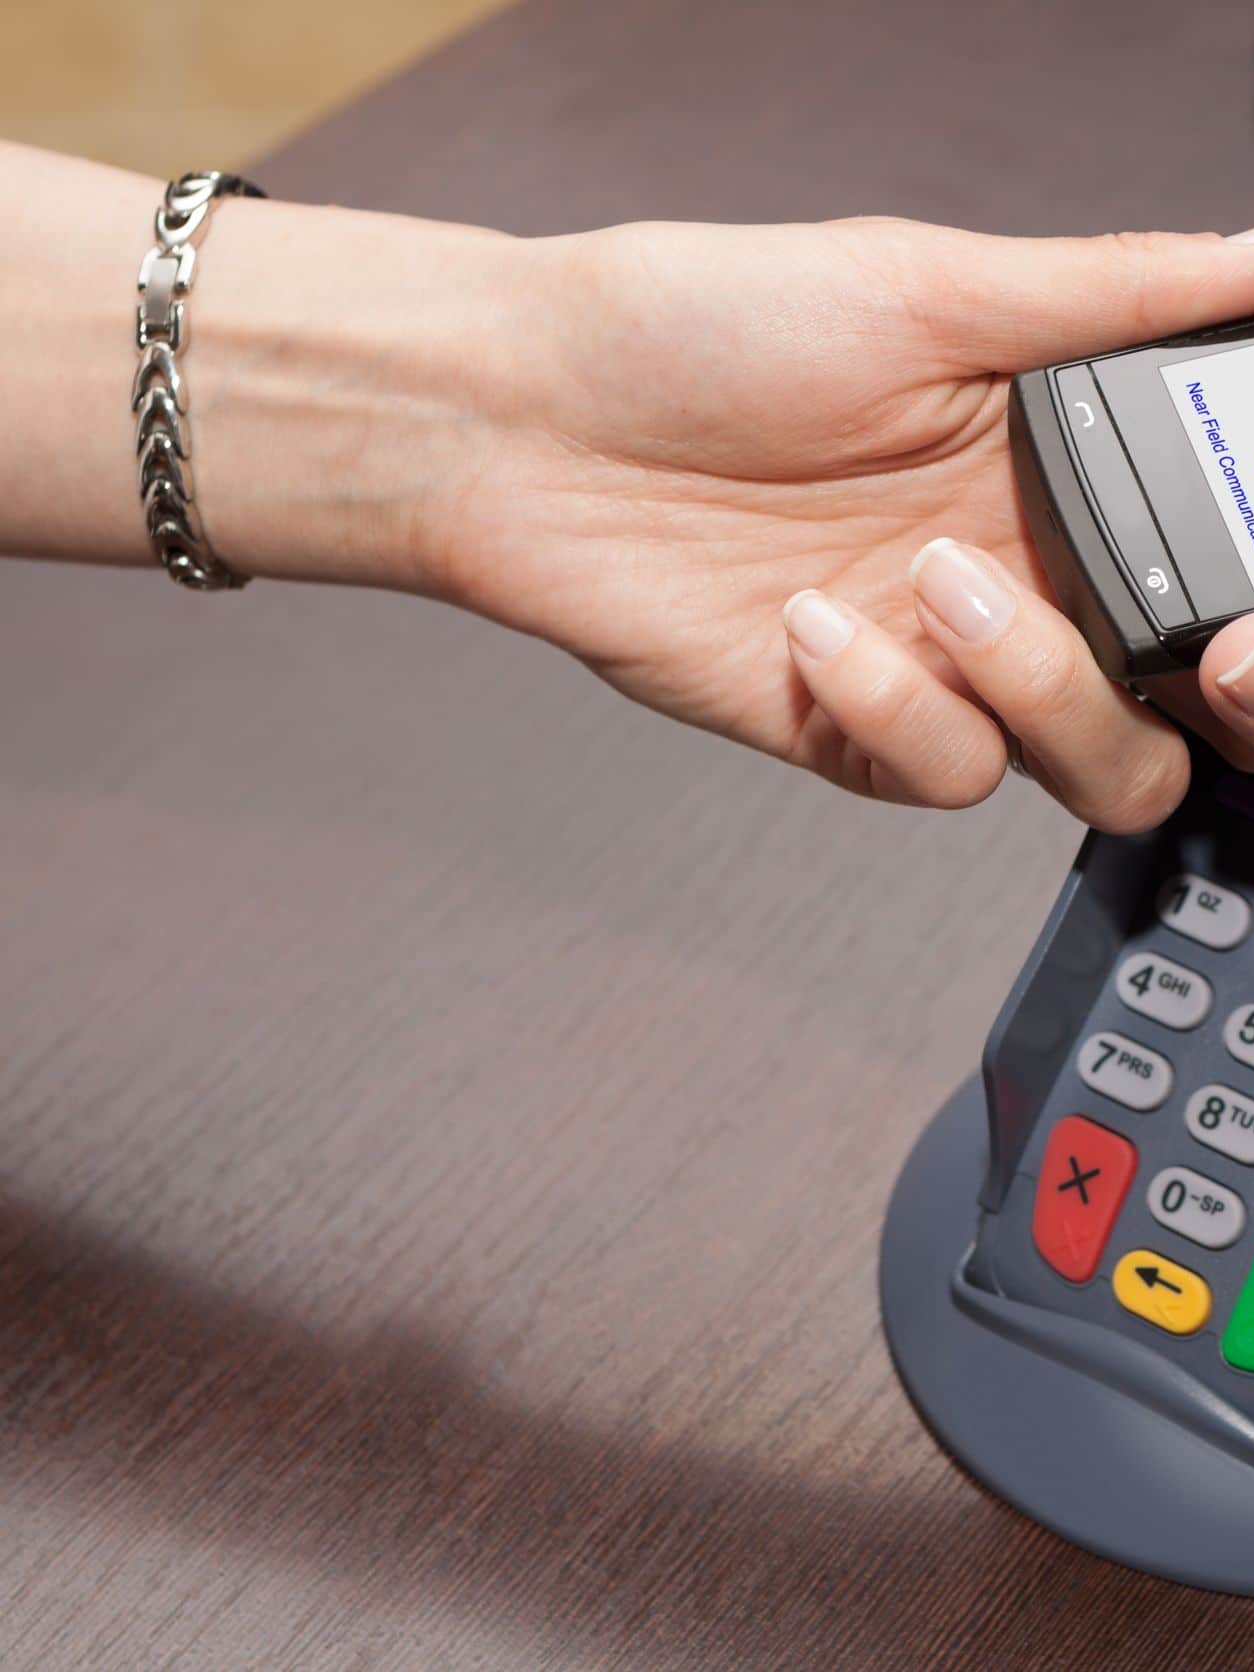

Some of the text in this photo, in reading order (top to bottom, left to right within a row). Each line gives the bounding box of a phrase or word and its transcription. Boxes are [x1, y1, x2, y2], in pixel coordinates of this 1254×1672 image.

[1186, 381, 1210, 416] Near
[1202, 418, 1229, 453] Field
[1127, 964, 1192, 999] 4 GHI
[1090, 1039, 1154, 1080] 7 PRS
[1198, 1095, 1227, 1131] 8
[1161, 1179, 1187, 1214] 0
